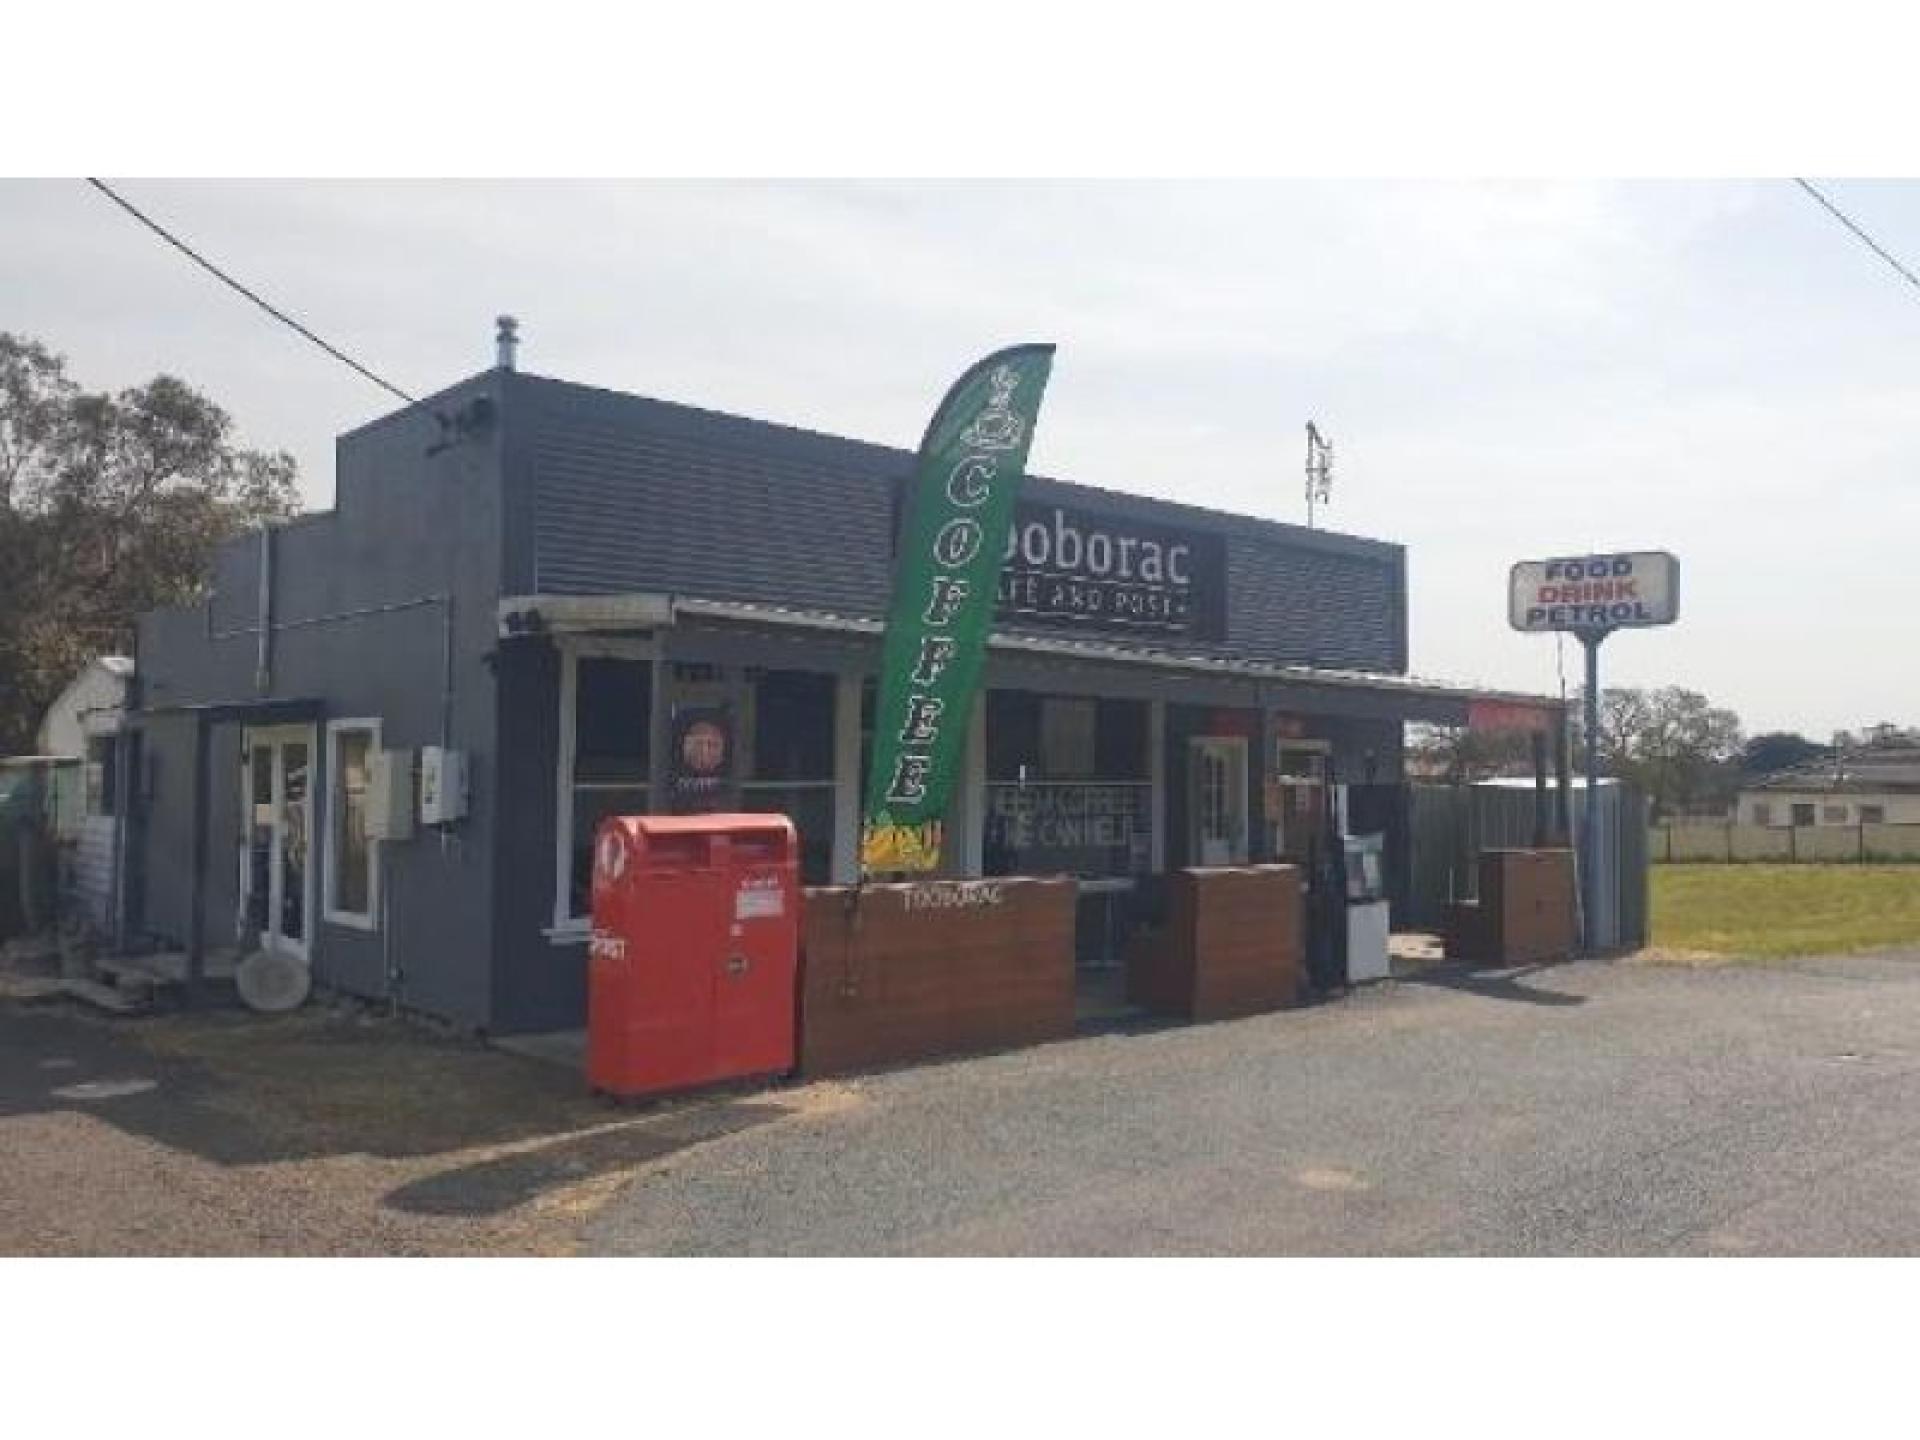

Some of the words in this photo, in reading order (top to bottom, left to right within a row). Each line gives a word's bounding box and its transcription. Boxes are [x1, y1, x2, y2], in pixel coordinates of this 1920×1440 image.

[1545, 556, 1632, 581] FOOD
[1536, 578, 1638, 604] DRINK
[1526, 602, 1652, 627] PETROL
[886, 454, 997, 804] COFFEE
